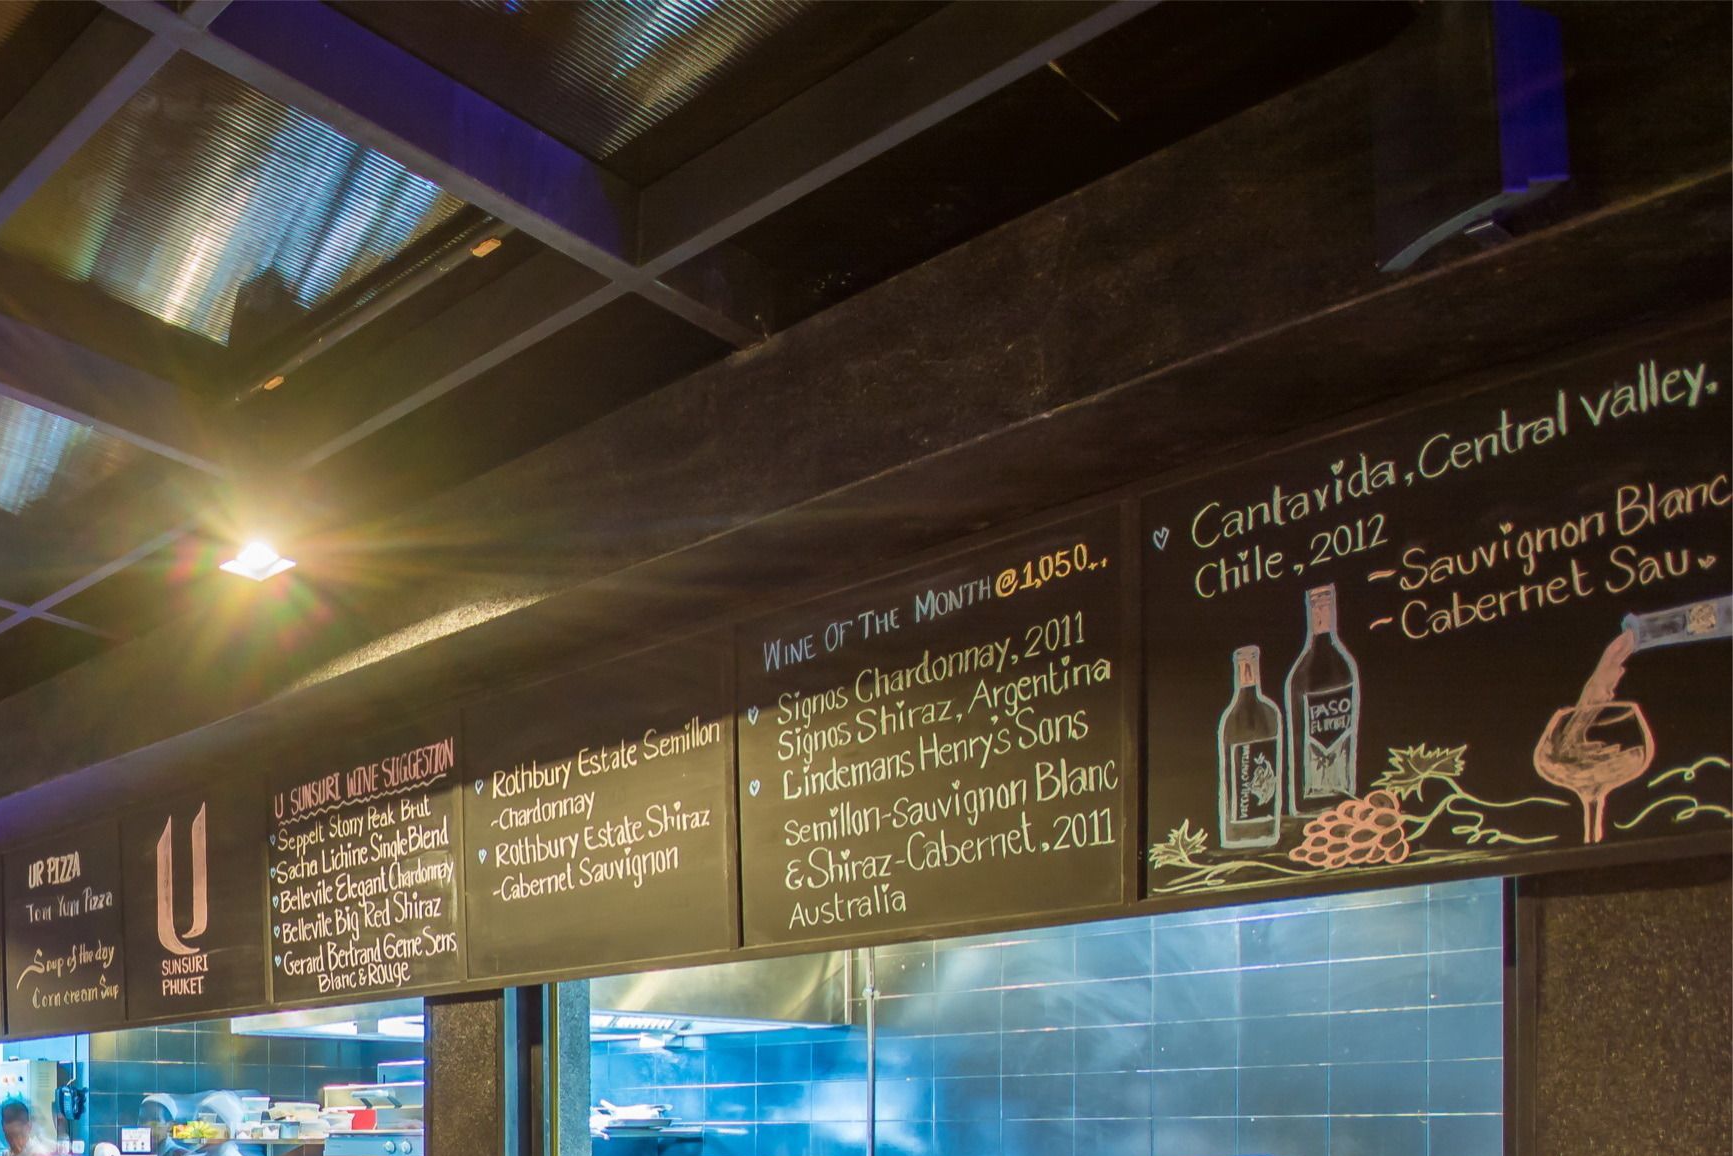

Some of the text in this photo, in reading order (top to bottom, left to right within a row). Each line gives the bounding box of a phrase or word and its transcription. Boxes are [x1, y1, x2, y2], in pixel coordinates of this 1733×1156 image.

[1418, 390, 1566, 479] Central
[1617, 474, 1733, 536] Blanc
[1195, 513, 1388, 599] Chile, 2012
[825, 620, 852, 652] OF
[777, 611, 1085, 727] Signos Chardonnay, 2011
[778, 655, 1111, 764] Signos Shiraz, Argentina
[1310, 698, 1351, 720] PASO
[274, 736, 454, 819] U SUNSURI WINE SUGGESTION
[492, 716, 720, 799] Rothbury Estate Semillon
[783, 750, 915, 800] Lindemans
[1035, 757, 1119, 803] Blanc
[276, 855, 318, 884] Sacha
[370, 829, 408, 863] Single
[407, 815, 449, 853] Blend
[277, 820, 325, 858] Seppelt
[368, 801, 396, 831] Peak
[401, 794, 431, 822] Brut
[495, 801, 711, 868] Rothbury Estate Shiraz
[1052, 807, 1116, 851] 2011
[47, 851, 81, 885] PIZZA
[156, 801, 208, 955] U
[335, 866, 388, 908] Elegant
[388, 857, 454, 891] Chardonnay
[579, 846, 679, 888] Sauvignon
[26, 886, 113, 923] Tom Yum Pizza
[335, 905, 360, 941] Big
[364, 898, 391, 928] Red
[393, 891, 442, 923] Shiraz
[788, 883, 907, 931] Australia
[162, 953, 209, 976] SUNSURI
[283, 944, 325, 976] Gerard
[326, 937, 382, 972] Bertrand
[317, 971, 357, 993] Blanc
[358, 968, 367, 986] &
[162, 975, 205, 996] PHUKET
